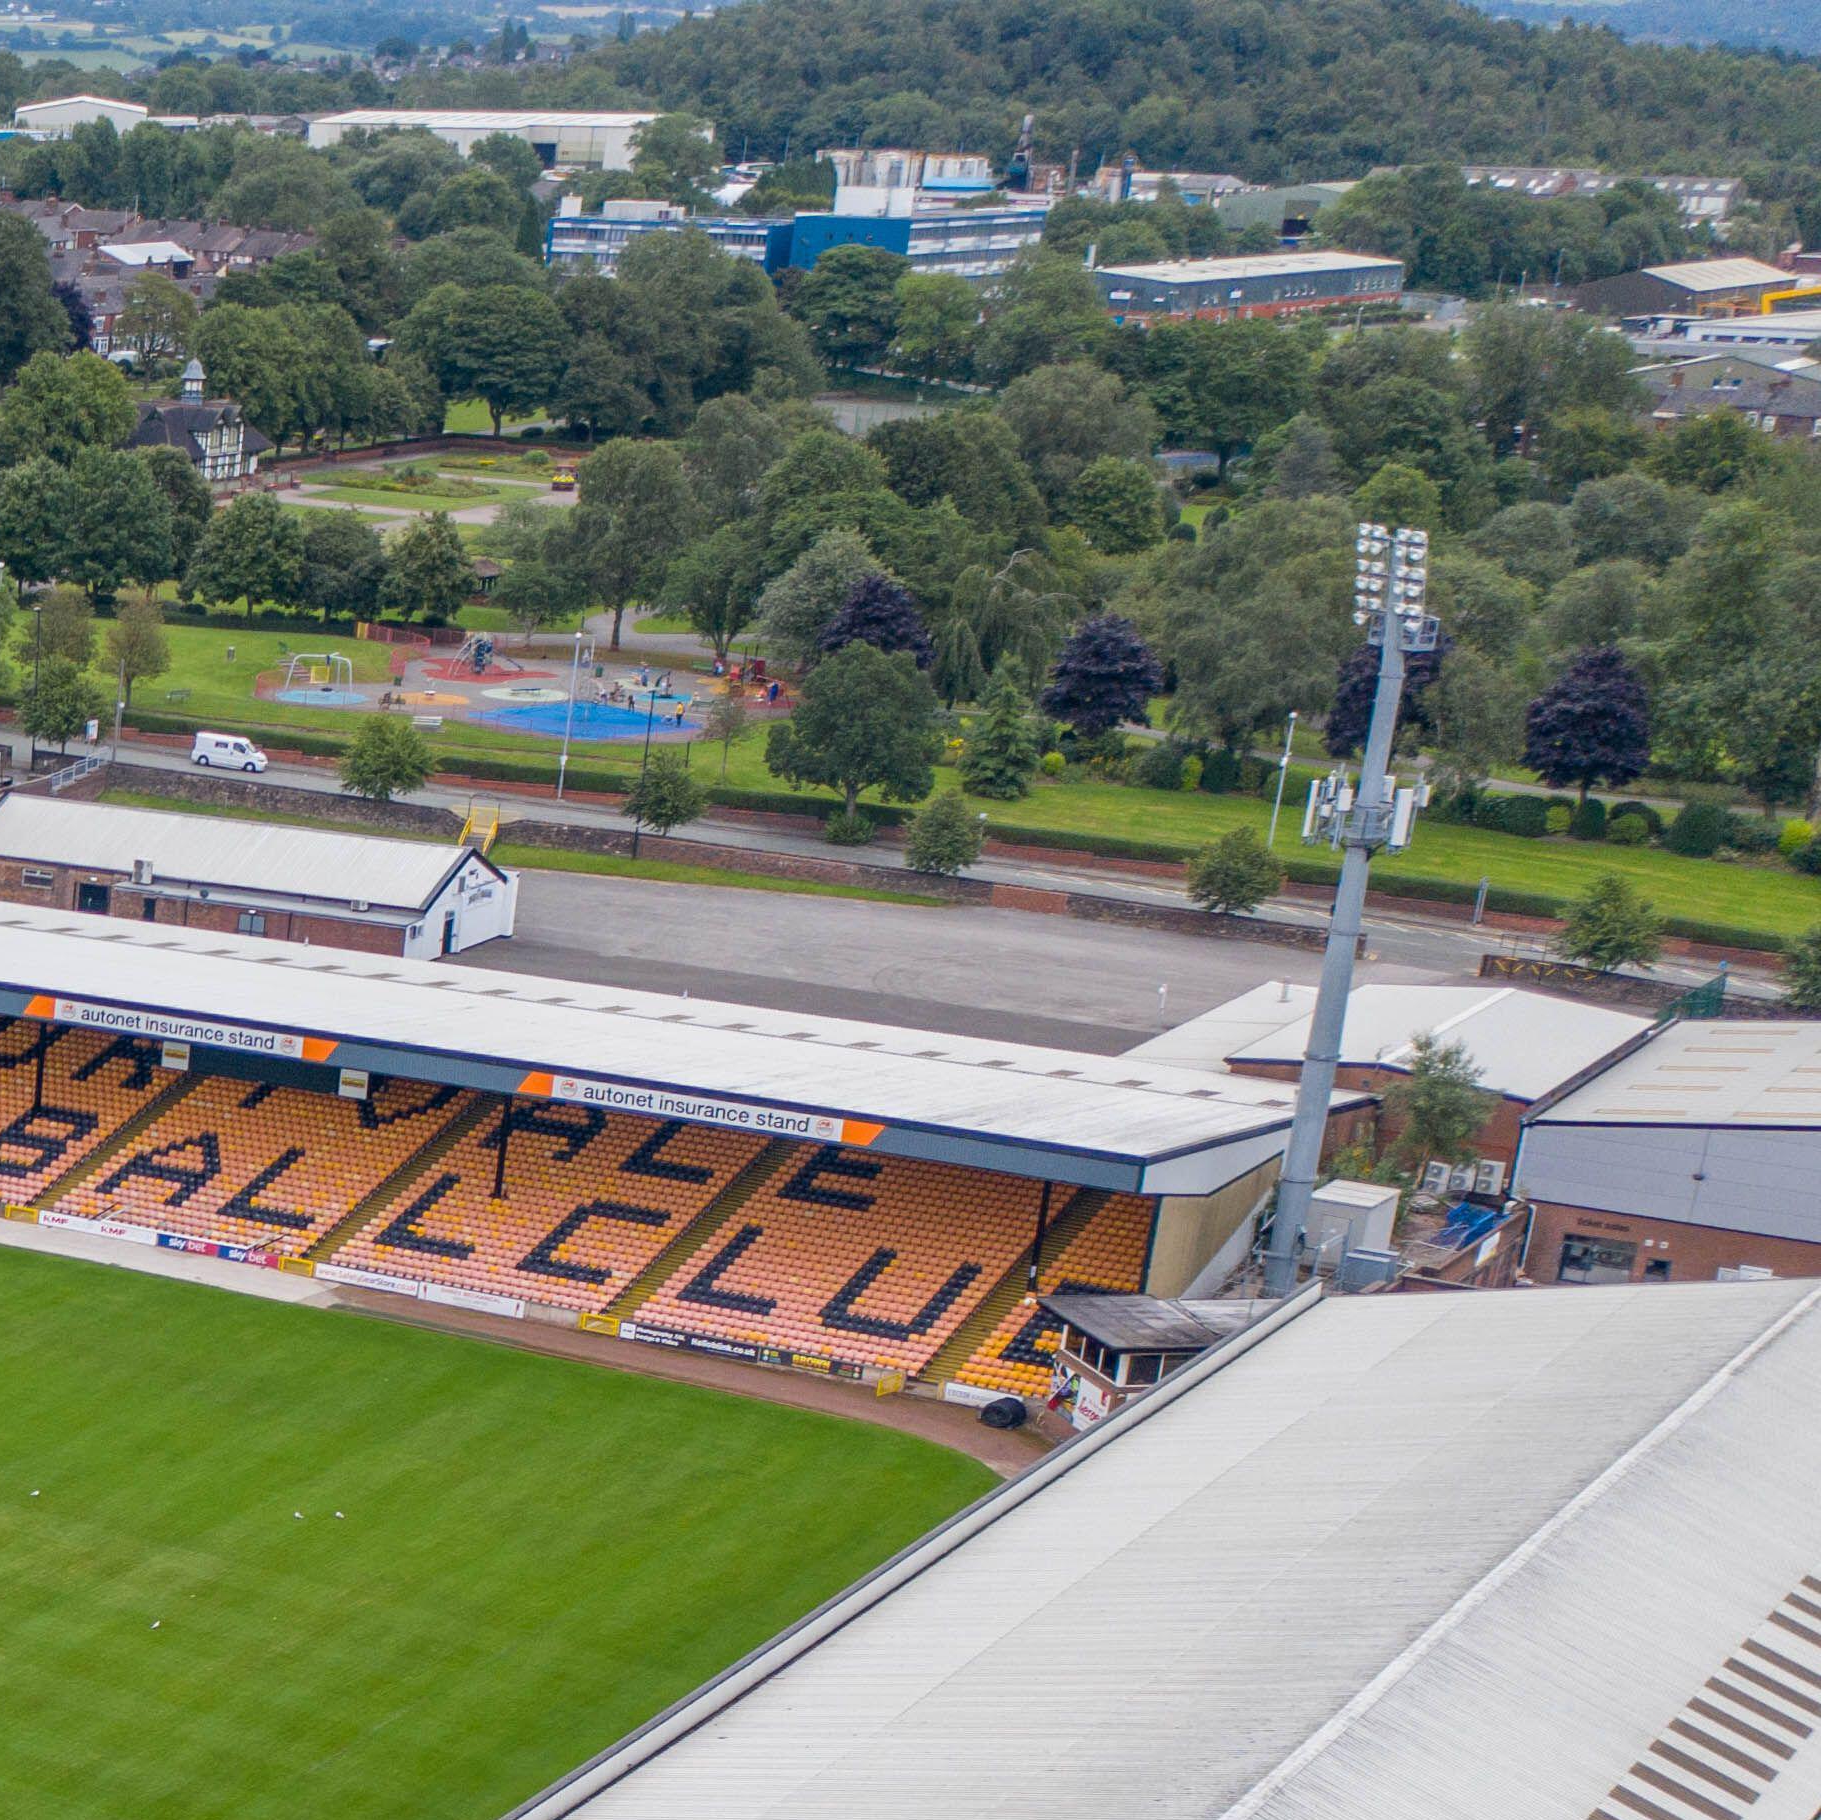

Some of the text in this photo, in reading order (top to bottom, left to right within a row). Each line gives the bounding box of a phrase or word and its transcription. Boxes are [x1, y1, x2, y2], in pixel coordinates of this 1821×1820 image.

[81, 1007, 275, 1050] autonet insurance stand
[583, 1085, 810, 1133] autonet insurance stand
[43, 1215, 69, 1225] KMF
[101, 1226, 126, 1237] KMF
[168, 1237, 206, 1253] sky bet
[228, 1248, 266, 1265] sky bet
[792, 1354, 831, 1369] BROWN
